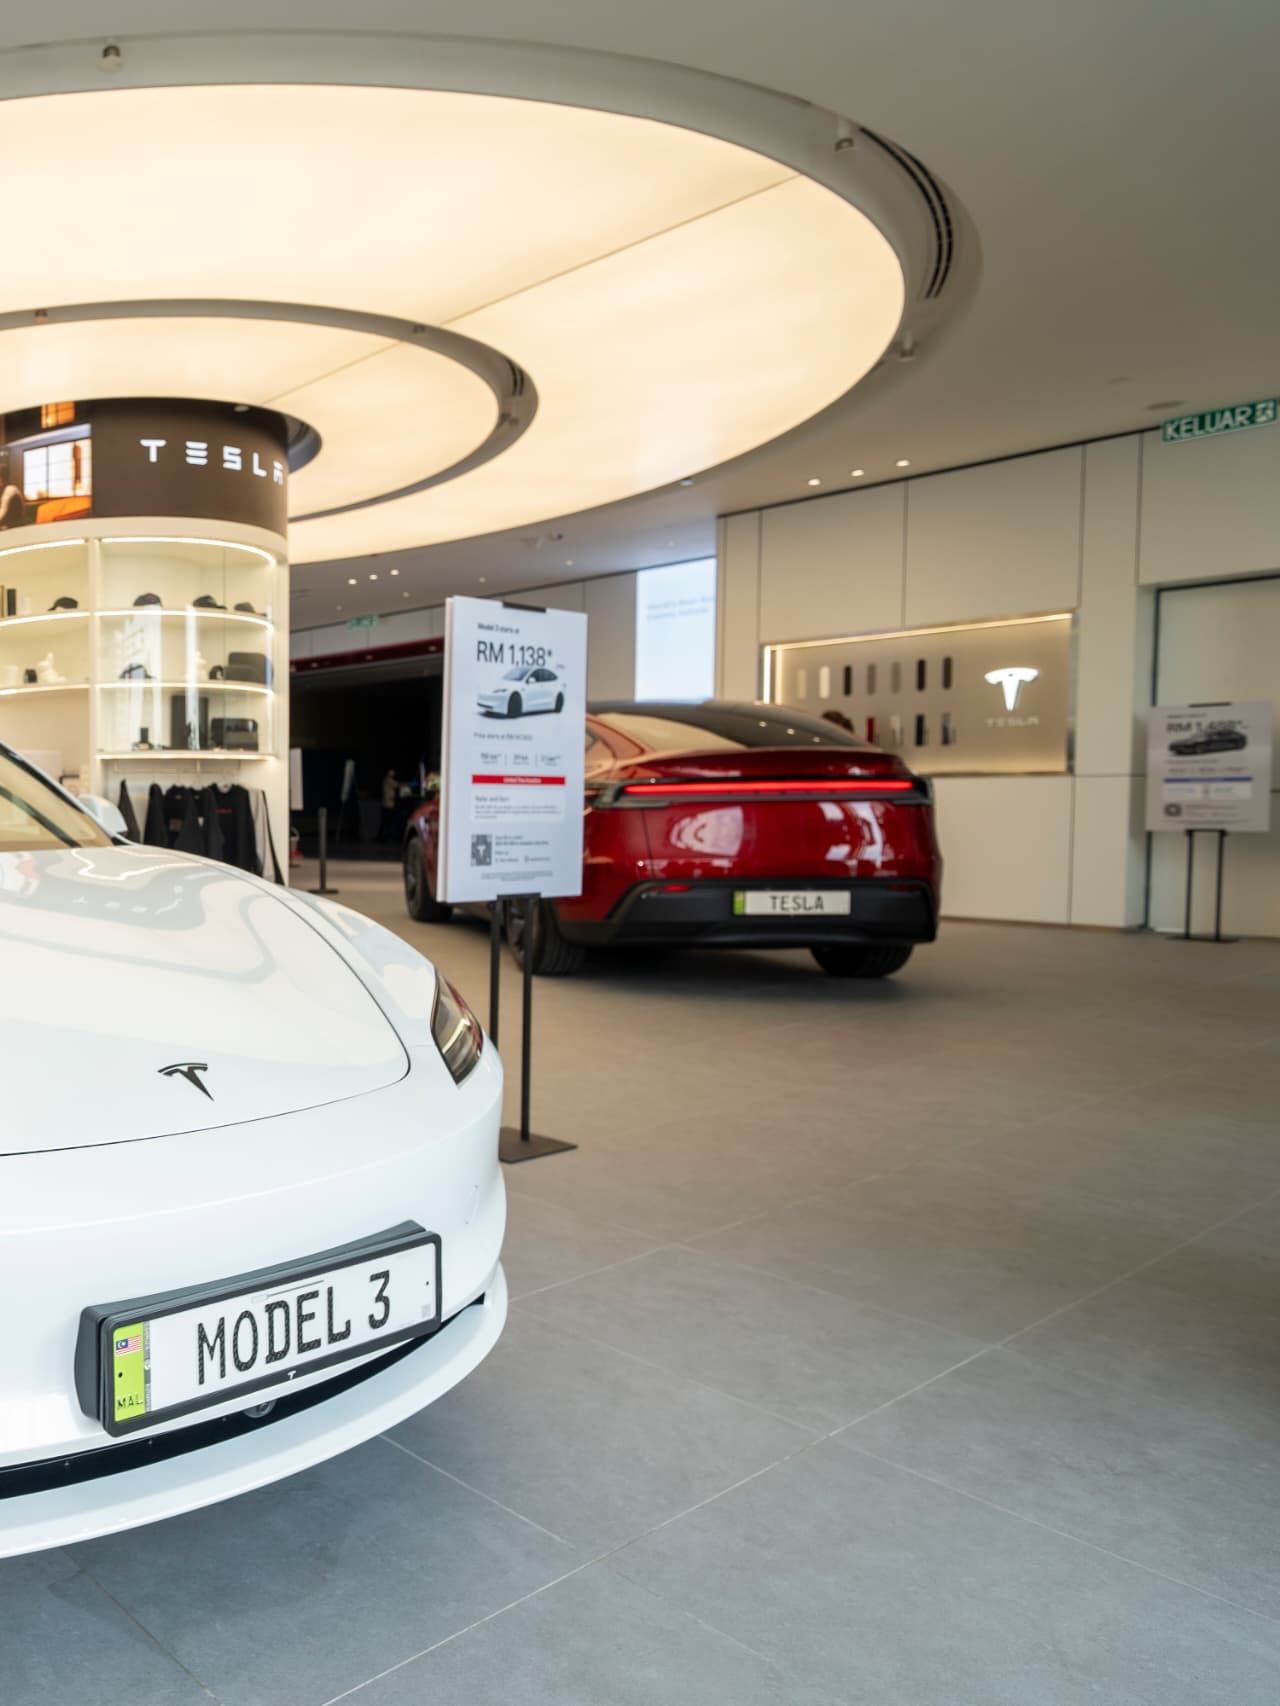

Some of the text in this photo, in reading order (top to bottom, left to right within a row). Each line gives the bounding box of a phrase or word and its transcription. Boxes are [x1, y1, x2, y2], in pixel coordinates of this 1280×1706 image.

[1165, 406, 1252, 439] KELUAR
[140, 438, 283, 486] TESLA
[476, 640, 504, 664] RM
[769, 895, 824, 911] TESLA
[197, 1286, 352, 1385] MODEL
[369, 1270, 391, 1331] 3
[117, 1393, 144, 1409] MAL
